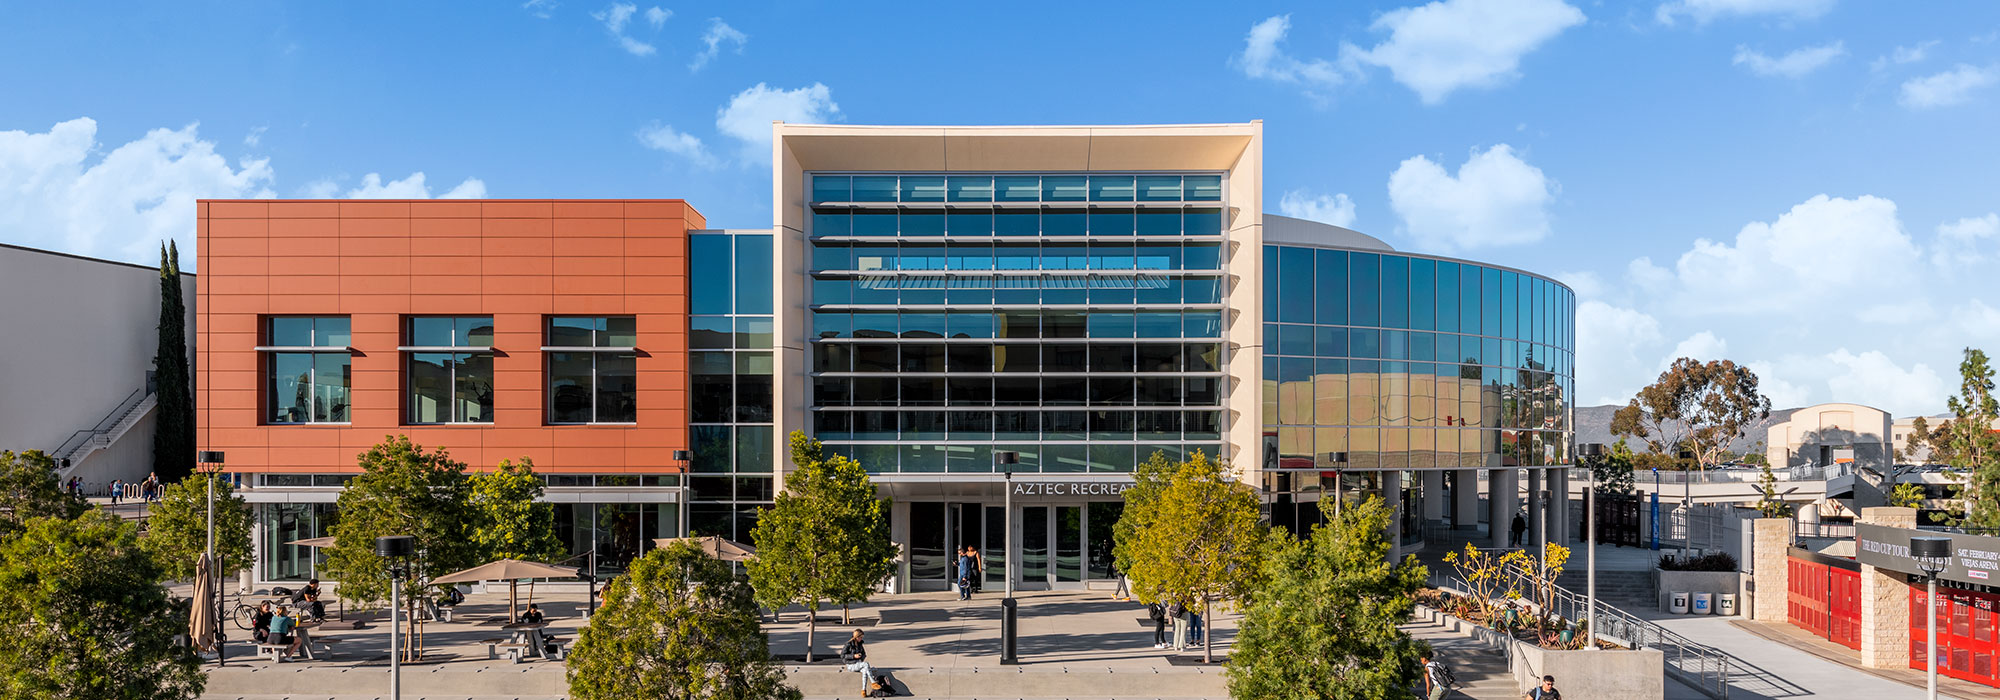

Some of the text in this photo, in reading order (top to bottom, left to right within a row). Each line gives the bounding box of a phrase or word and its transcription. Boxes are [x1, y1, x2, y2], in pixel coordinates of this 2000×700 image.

[1014, 483, 1065, 495] AZTEC
[1871, 540, 1880, 553] RED
[1880, 542, 1892, 555] CUP
[1891, 544, 1910, 558] TOUR
[1969, 549, 1998, 560] FEBRUARY
[1961, 558, 1979, 568] VIEJAS
[1978, 560, 1999, 570] ARENA
[1940, 579, 1991, 593] ELCOME
